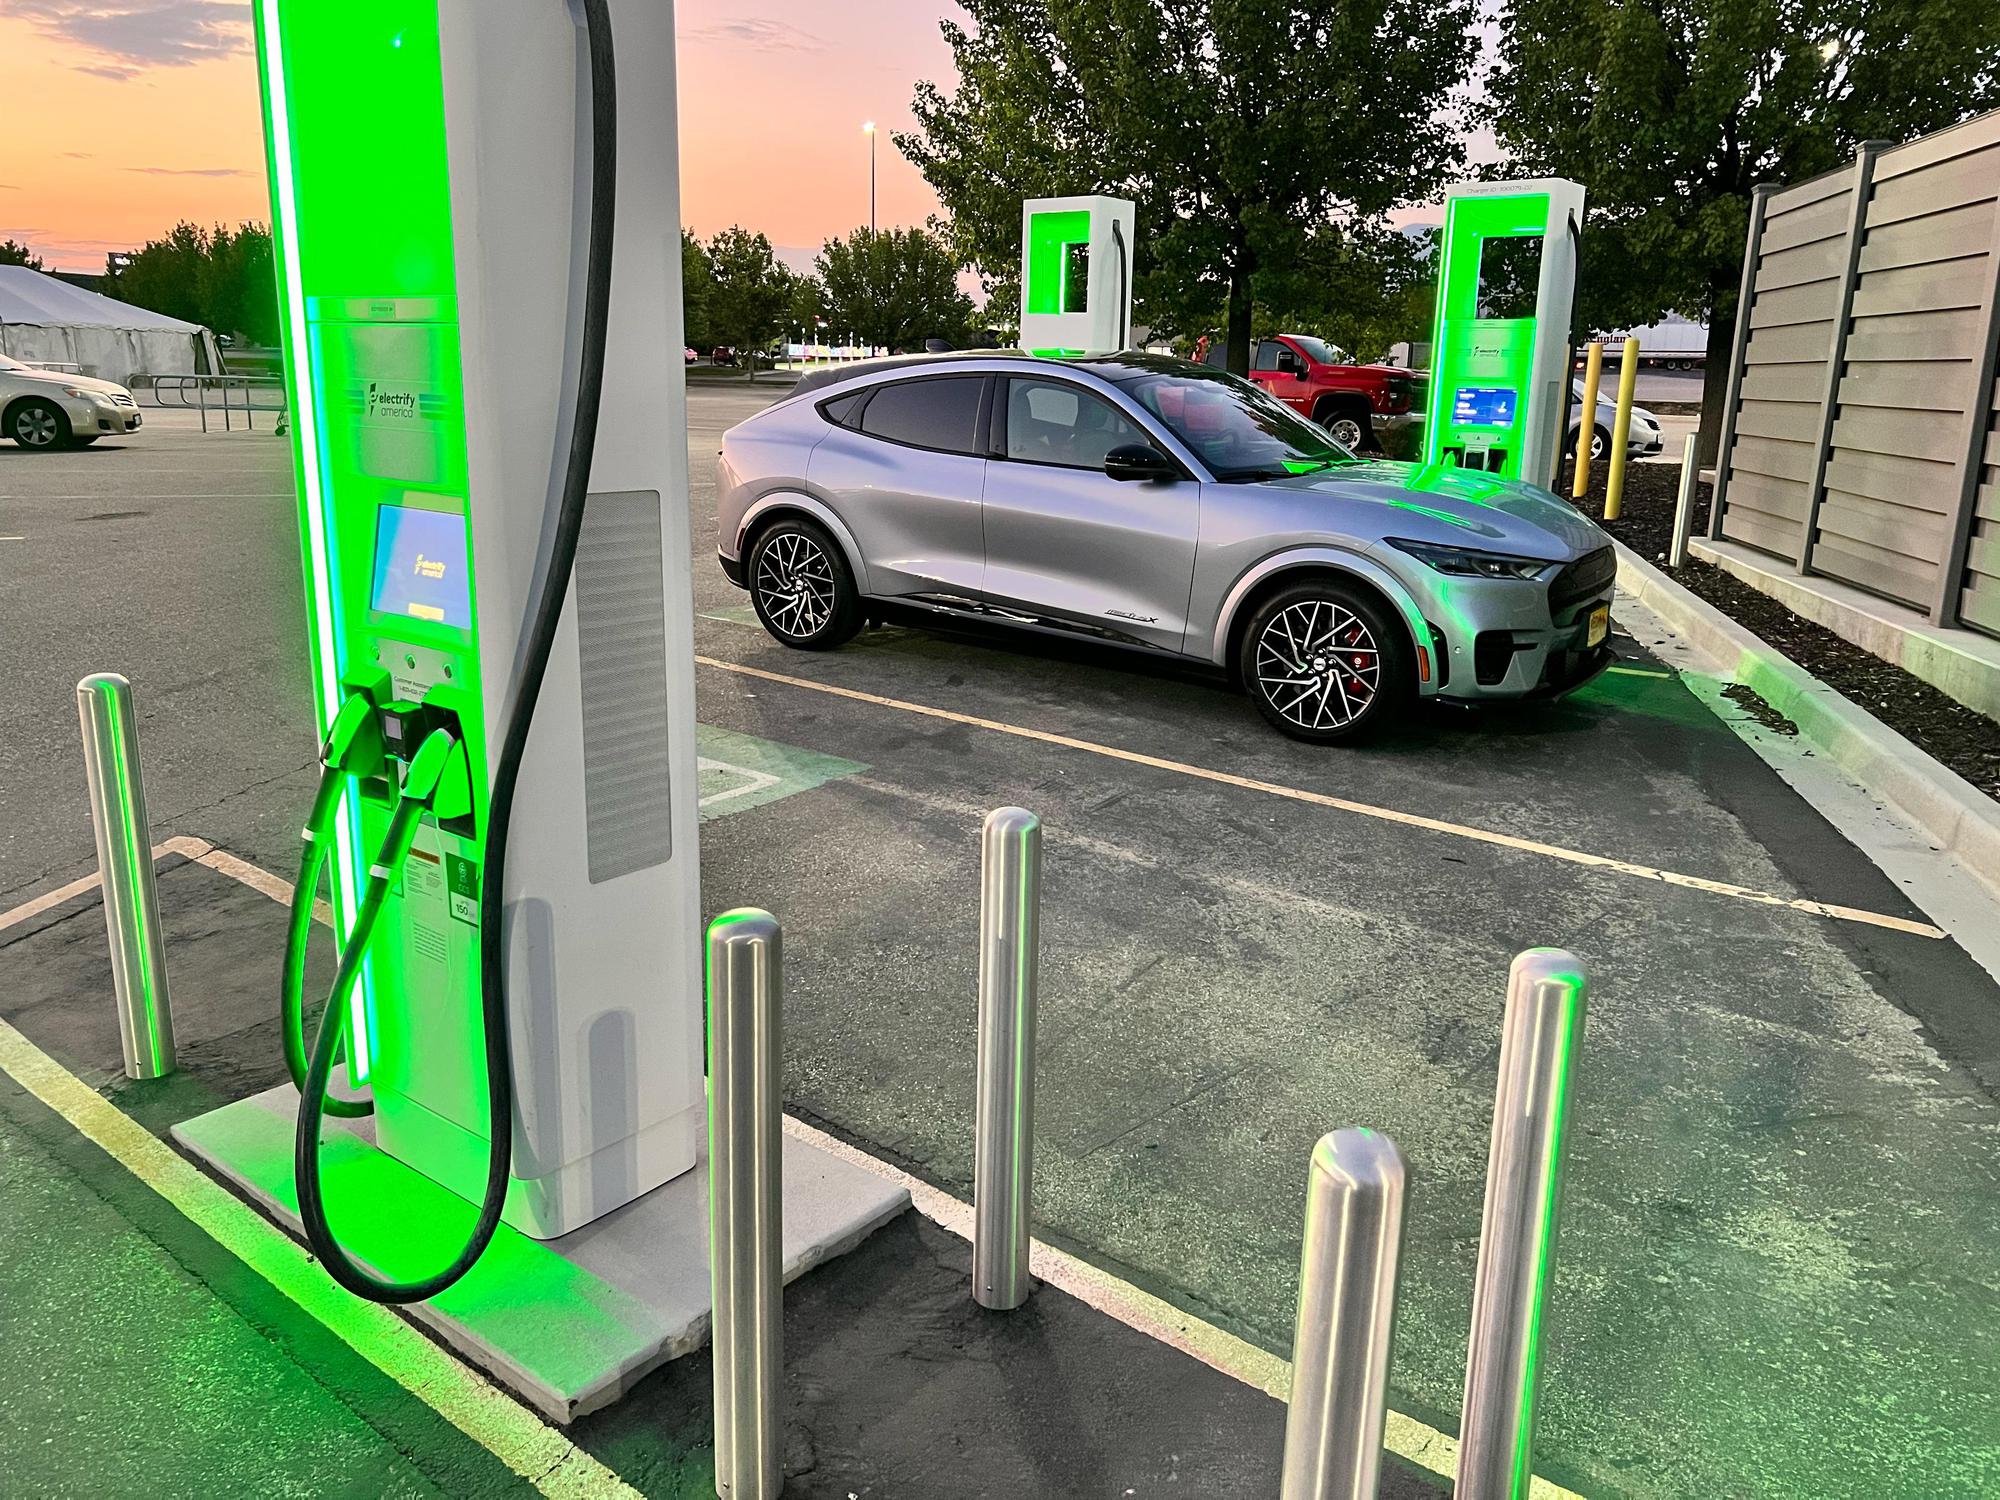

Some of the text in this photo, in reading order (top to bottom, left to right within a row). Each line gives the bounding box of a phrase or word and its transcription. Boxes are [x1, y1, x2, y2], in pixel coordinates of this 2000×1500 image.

[379, 392, 415, 408] electrify
[381, 406, 413, 418] america
[456, 903, 469, 916] 150
